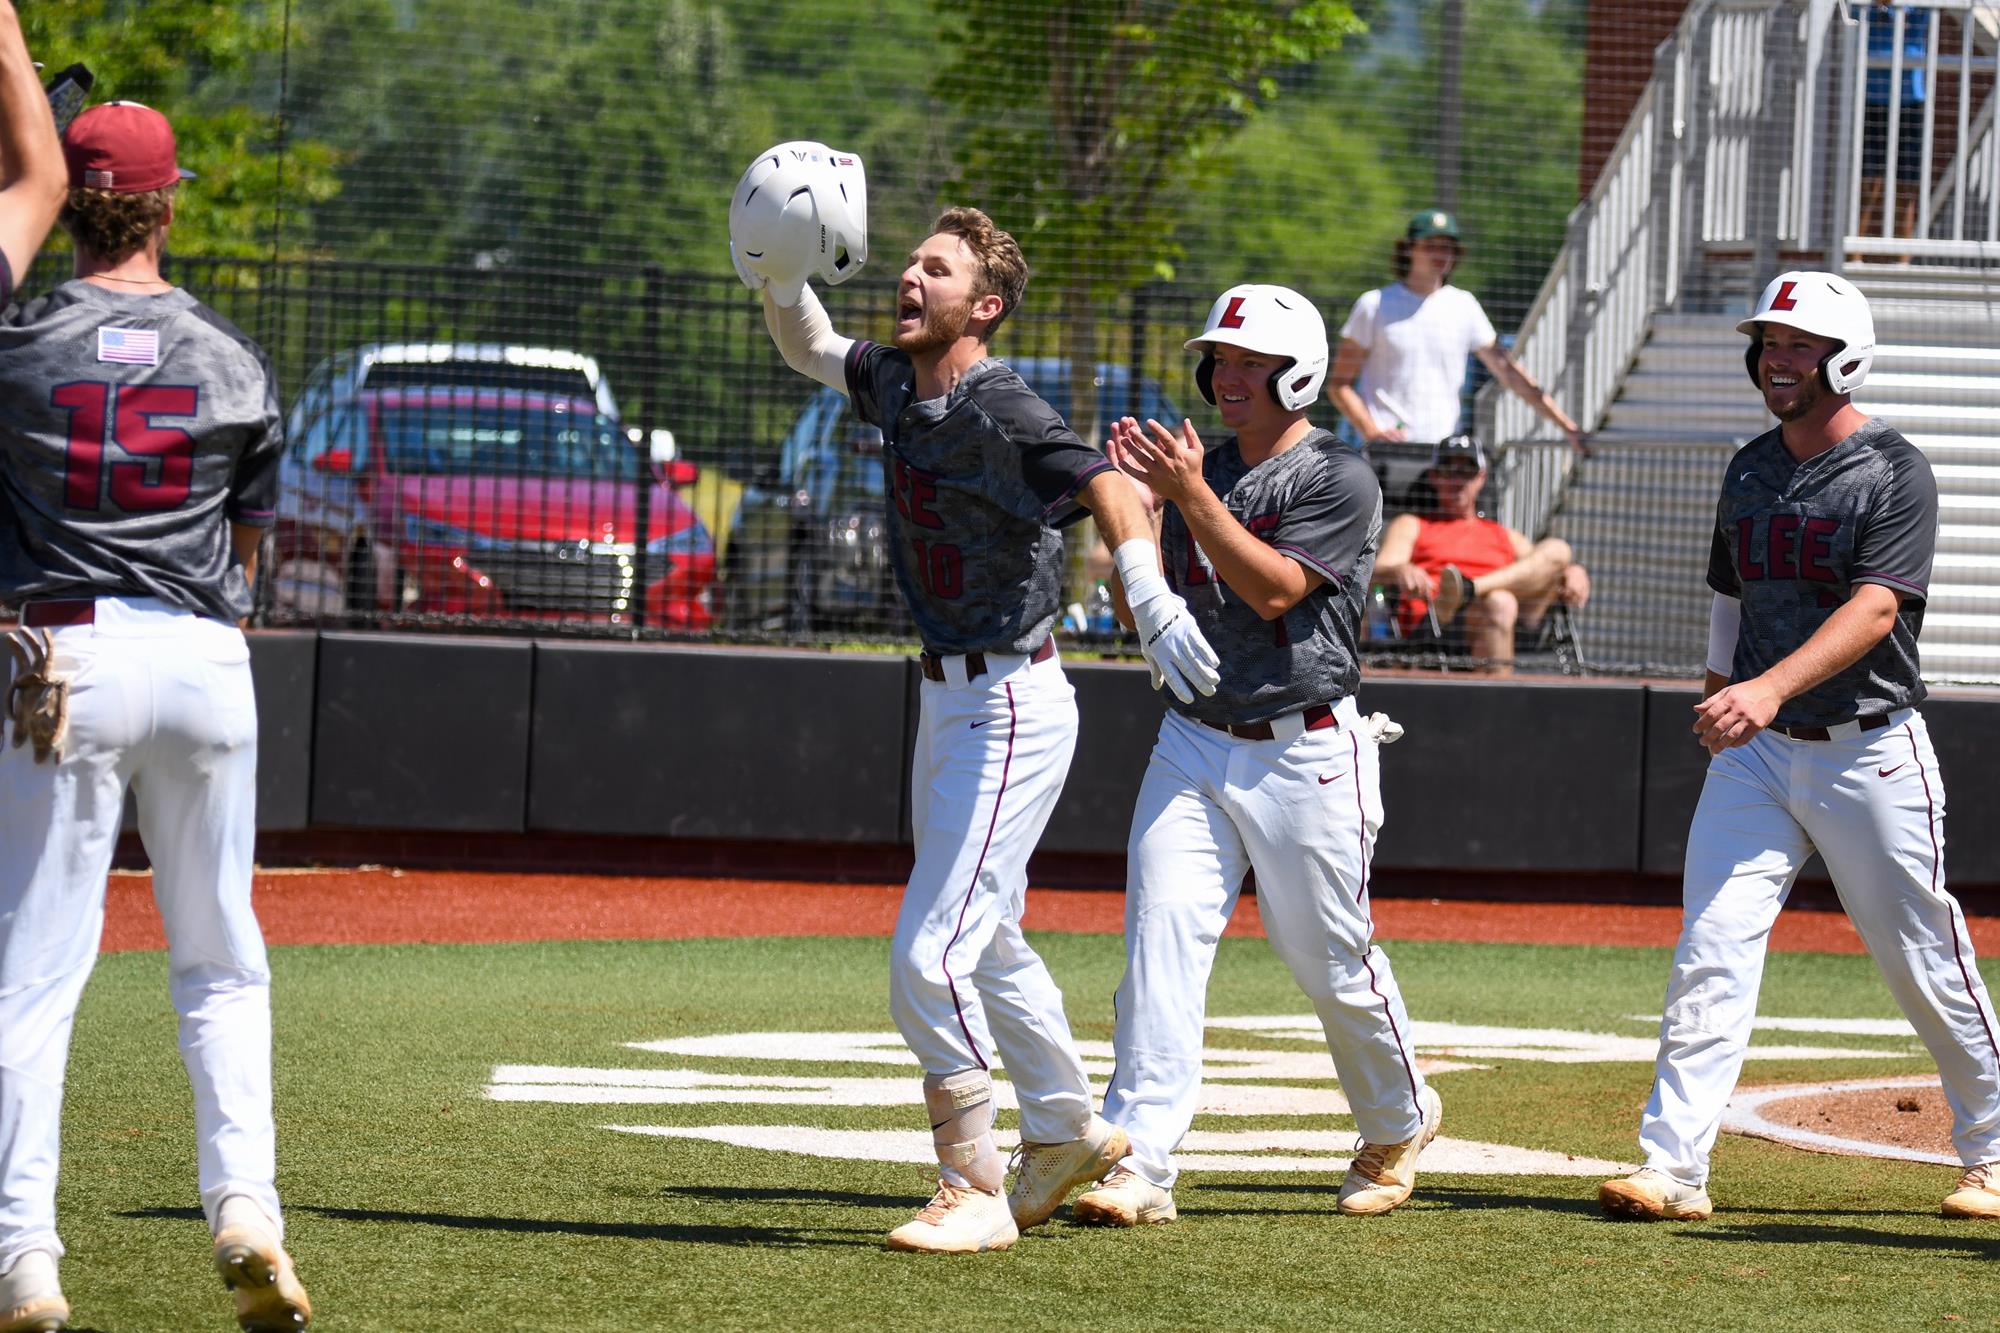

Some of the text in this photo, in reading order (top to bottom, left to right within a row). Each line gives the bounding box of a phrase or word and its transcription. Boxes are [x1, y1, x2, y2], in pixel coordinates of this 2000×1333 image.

[1217, 297, 1246, 329] L
[1768, 281, 1798, 311] L
[50, 379, 199, 512] 15
[912, 538, 963, 600] 10
[1736, 513, 1841, 584] LEE
[1148, 614, 1179, 647] EASTON
